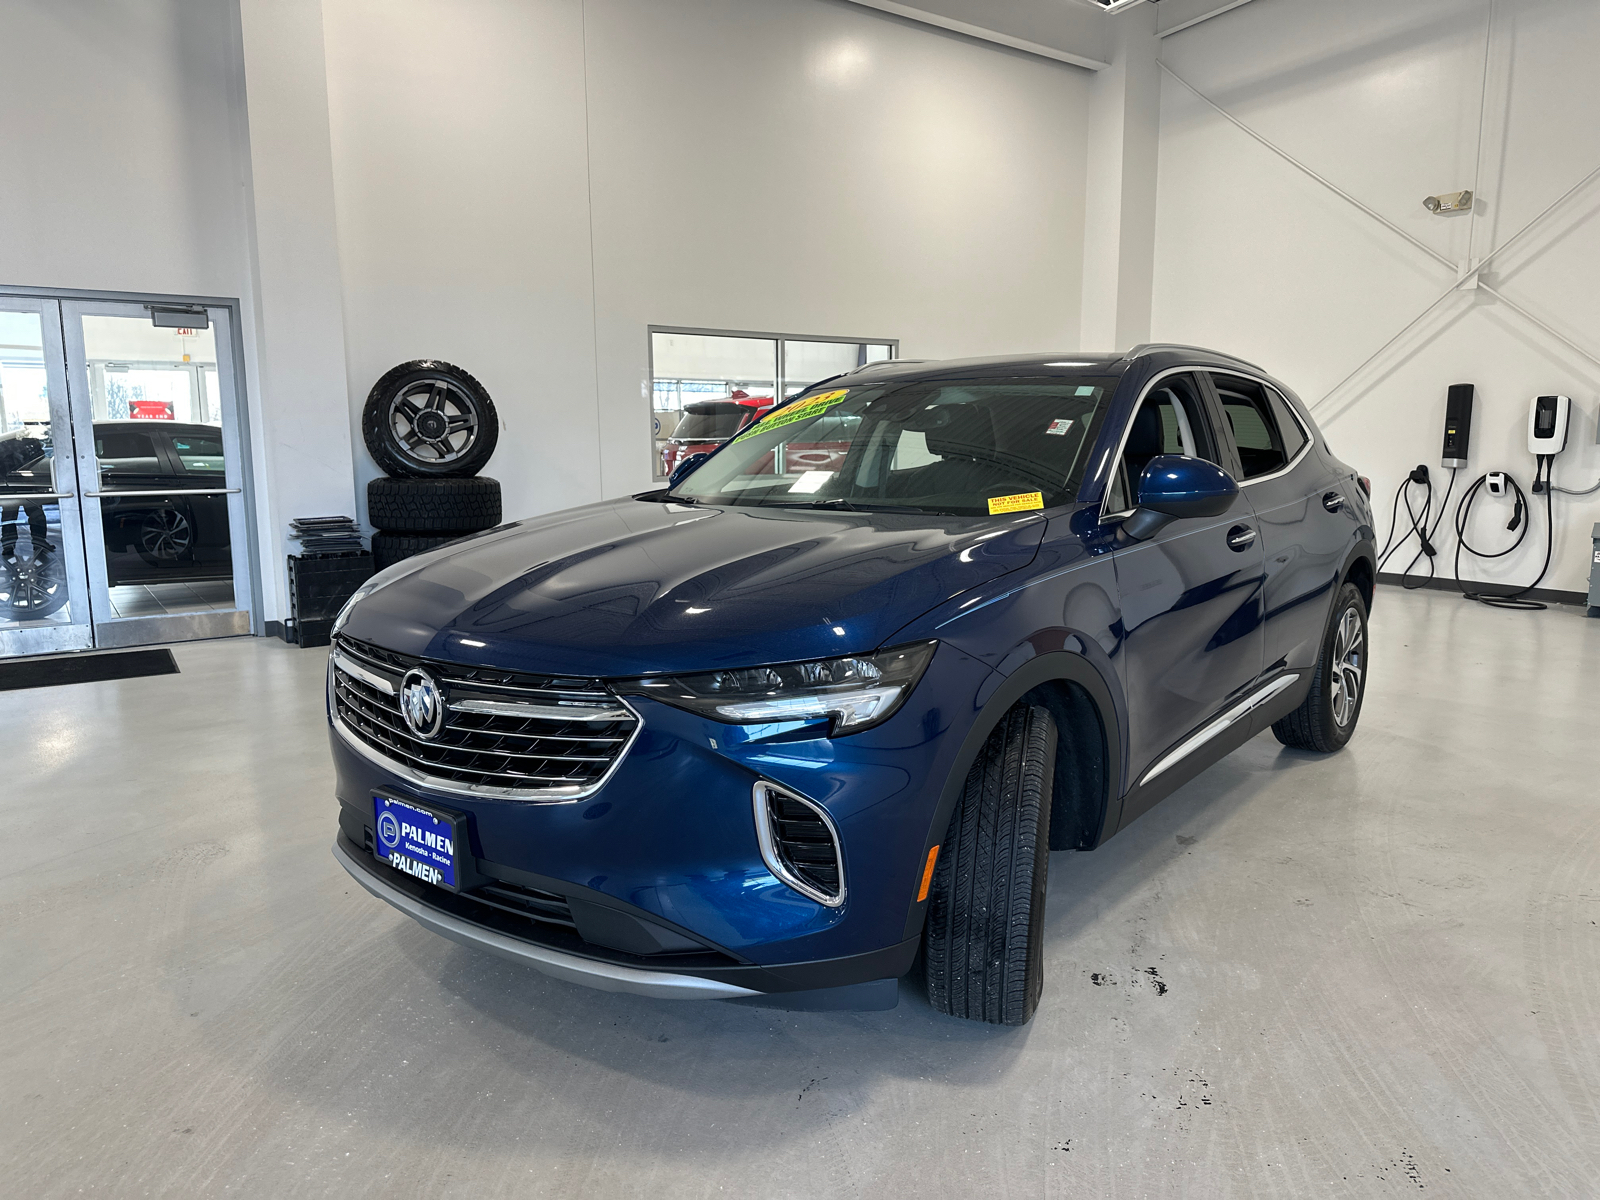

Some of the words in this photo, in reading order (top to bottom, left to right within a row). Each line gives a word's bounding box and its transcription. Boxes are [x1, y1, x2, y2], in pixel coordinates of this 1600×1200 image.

[760, 414, 795, 432] BUTTON
[795, 406, 826, 420] START
[773, 406, 809, 421] WHEEL
[810, 397, 843, 410] DRIVE
[388, 798, 433, 817] palmen.com
[401, 822, 454, 856] PALMEN
[405, 841, 429, 858] Kenosha
[432, 852, 451, 867] Racine
[392, 852, 438, 885] PALMEN
